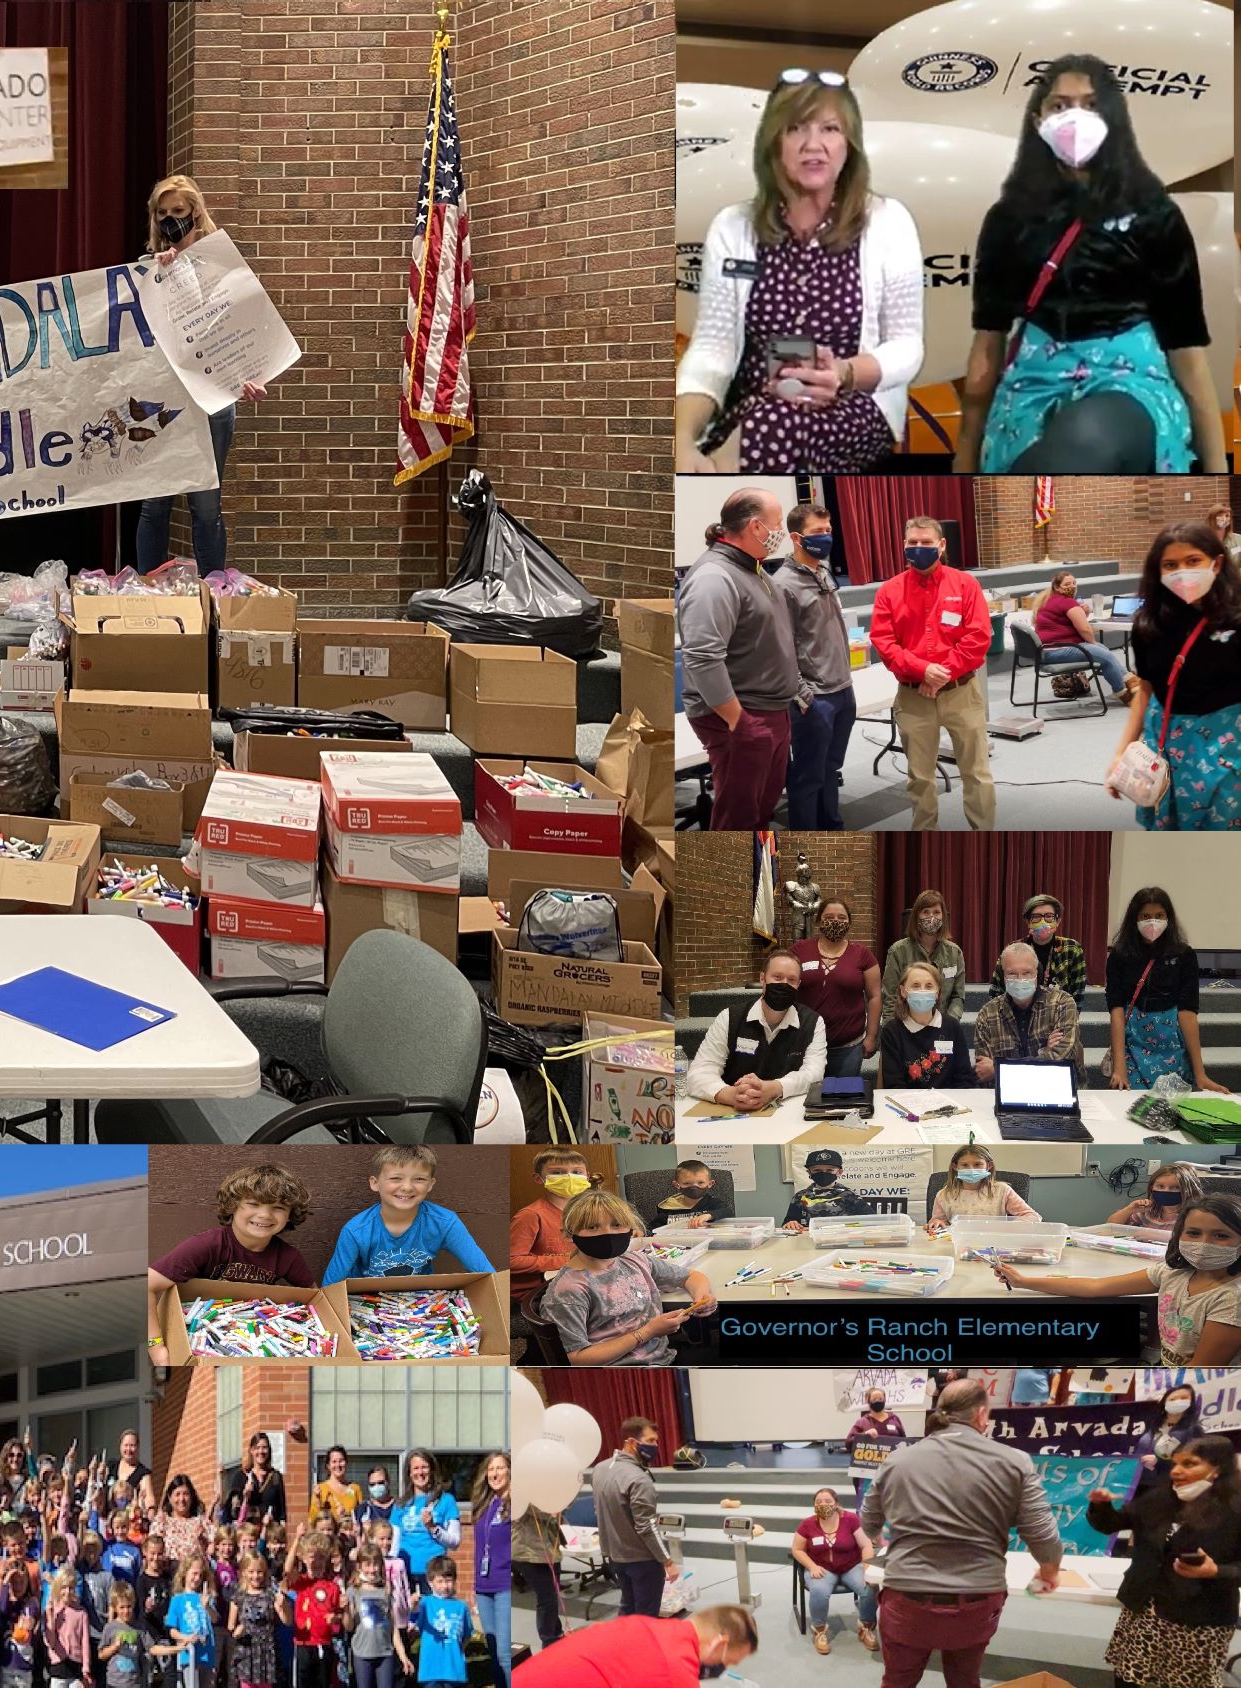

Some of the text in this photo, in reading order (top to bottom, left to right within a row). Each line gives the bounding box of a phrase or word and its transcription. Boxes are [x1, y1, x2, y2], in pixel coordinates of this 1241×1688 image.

[182, 316, 204, 331] EVERY
[205, 308, 218, 318] DAY
[350, 698, 374, 706] MARY
[543, 828, 588, 838] Copy Paper
[561, 962, 608, 975] NATURAL
[508, 1002, 581, 1018] ORGANIC RASPBERRIES
[869, 1149, 884, 1158] day
[883, 1172, 916, 1181] Engage.
[886, 1187, 910, 1195] WE:
[3, 1232, 93, 1266] SCHOOL
[888, 1390, 905, 1403] HS
[1028, 1416, 1146, 1439] Arvada
[1078, 1459, 1122, 1488] of
